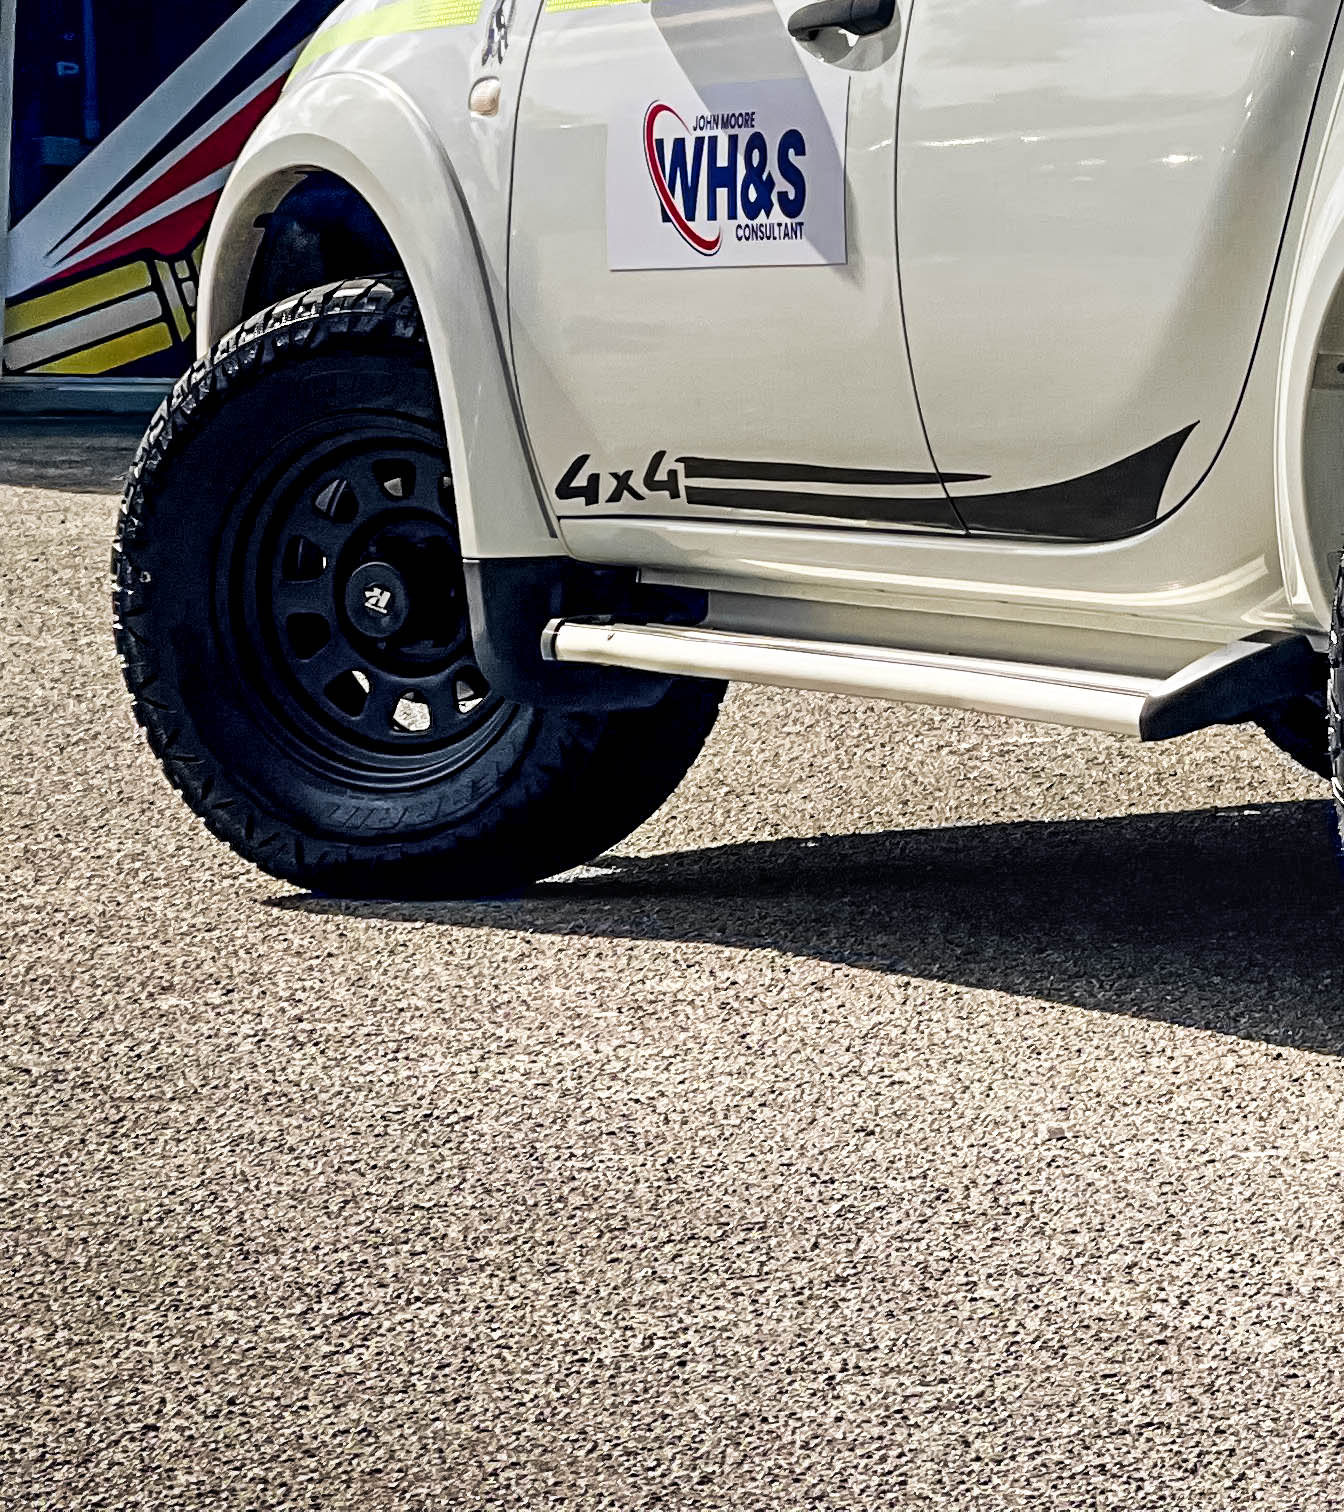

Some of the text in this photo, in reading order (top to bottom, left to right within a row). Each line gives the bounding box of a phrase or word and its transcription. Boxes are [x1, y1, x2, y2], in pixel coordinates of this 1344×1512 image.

[692, 111, 756, 132] JOHN MOORE
[654, 128, 807, 224] WH&S
[735, 221, 805, 242] CONSULTANT
[555, 449, 686, 507] 4x4
